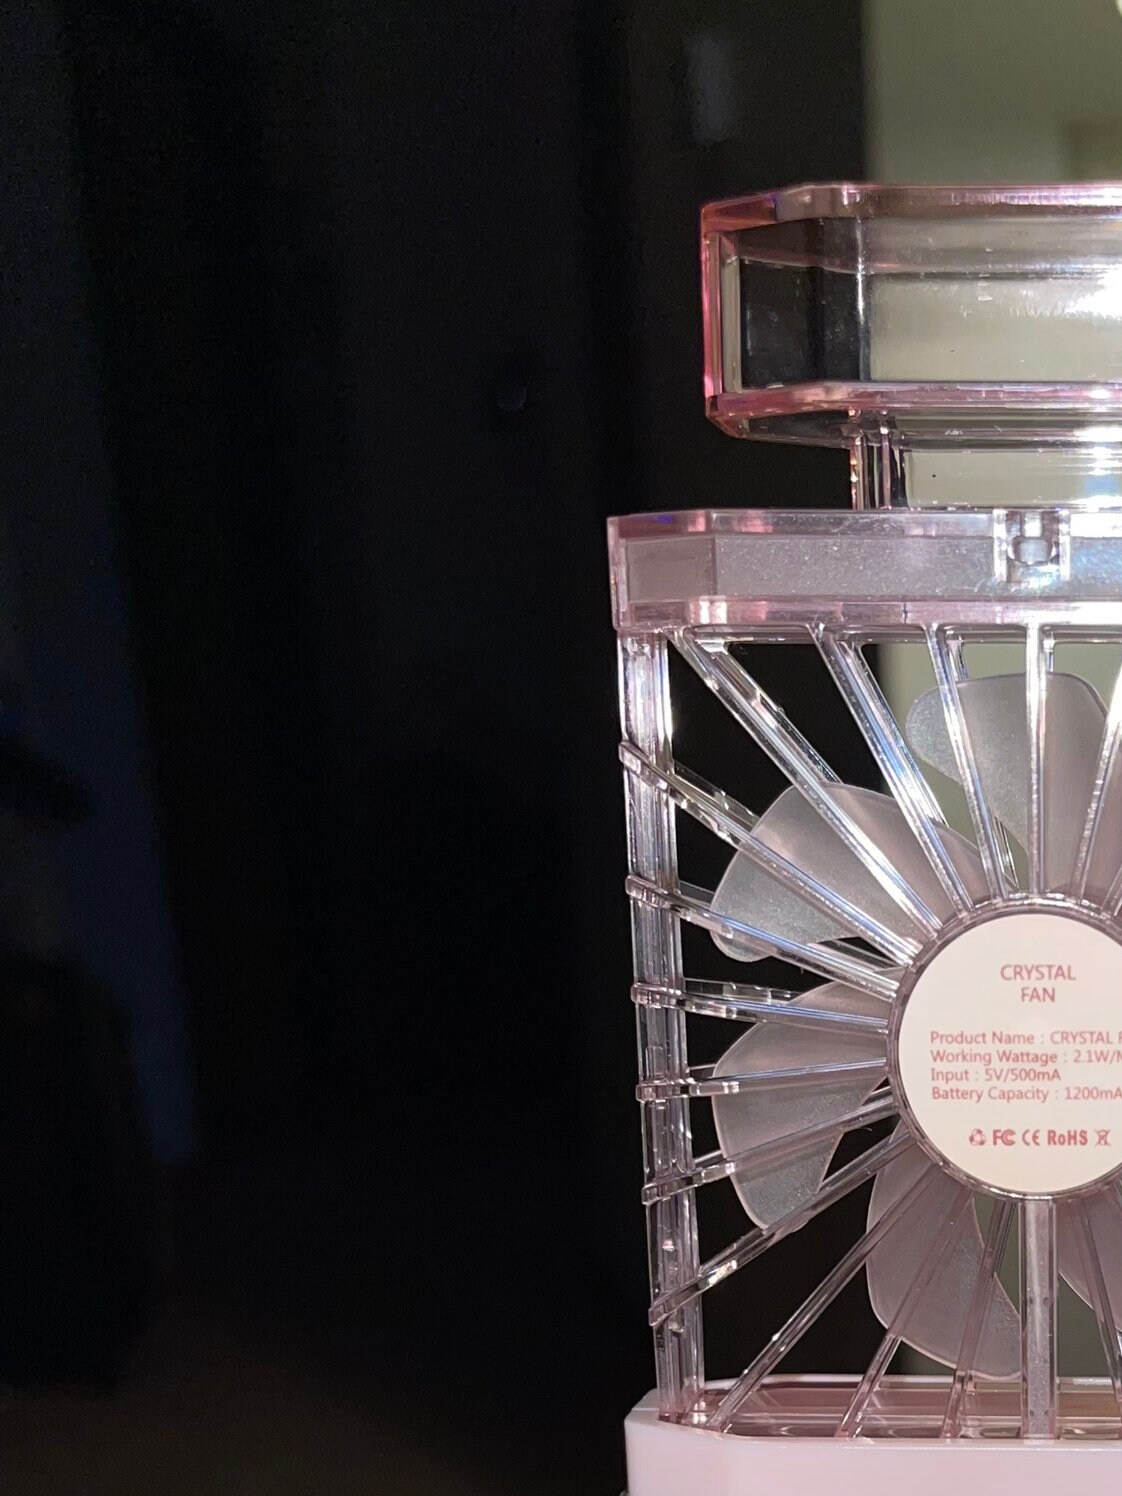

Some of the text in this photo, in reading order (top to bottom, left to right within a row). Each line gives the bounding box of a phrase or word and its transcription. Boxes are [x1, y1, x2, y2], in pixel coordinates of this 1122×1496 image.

[1000, 965, 1076, 981] CRYSTAL
[1020, 987, 1056, 1002] FAN
[930, 1031, 987, 1045] Product
[992, 1032, 1035, 1045] Name
[1050, 1031, 1112, 1045] CRYSTAL
[930, 1050, 992, 1066] Working
[997, 1050, 1058, 1066] Wattage
[931, 1069, 970, 1084] Input
[984, 1068, 1061, 1083] 5V/500mA
[931, 1087, 983, 1103] Battery
[988, 1087, 1049, 1103] Capacity
[1022, 1129, 1041, 1147] CE
[1047, 1130, 1089, 1147] RoHS
